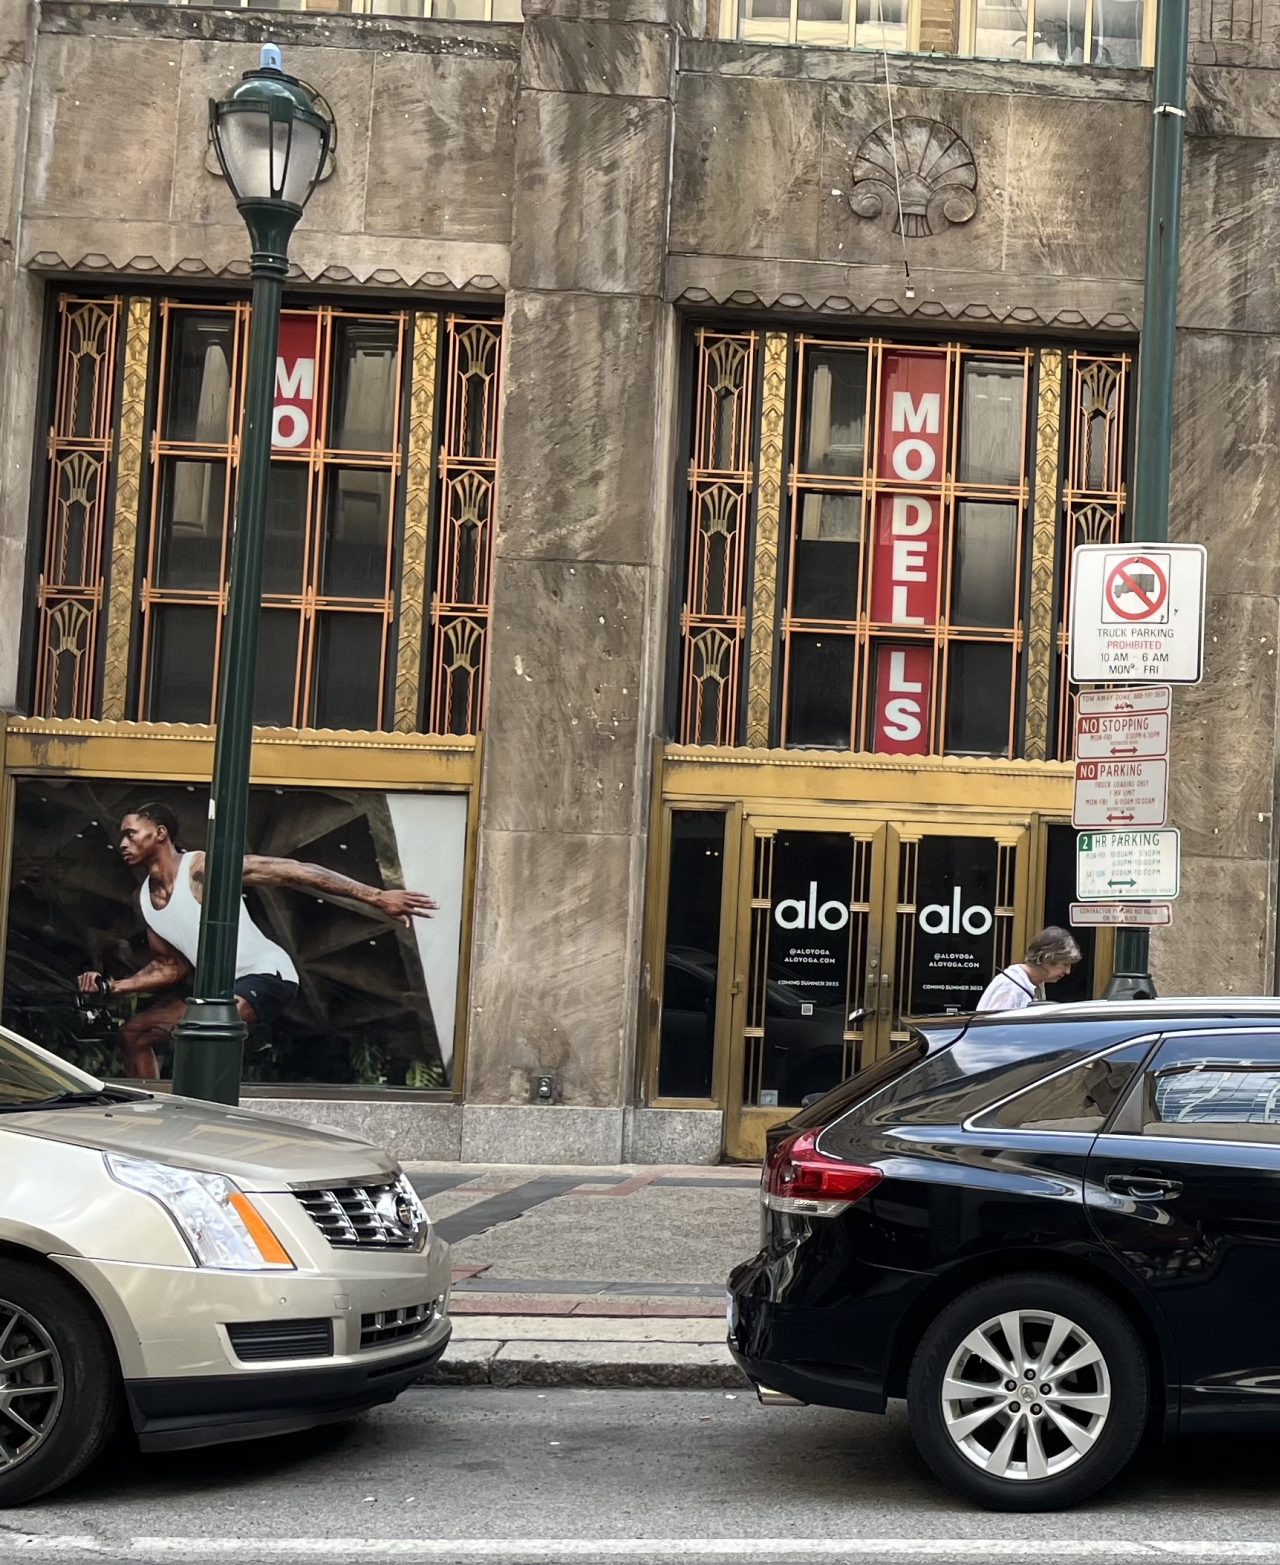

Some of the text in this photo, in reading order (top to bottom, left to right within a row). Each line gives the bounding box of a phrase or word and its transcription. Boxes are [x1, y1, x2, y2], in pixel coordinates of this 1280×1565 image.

[1098, 628, 1175, 638] TRUCK PARKING
[1107, 640, 1162, 650] PROHIBITED
[1101, 653, 1110, 662] 10
[1113, 653, 1128, 662] AM
[1142, 653, 1148, 662] 6
[1152, 653, 1169, 662] AM
[1109, 665, 1130, 674] MON
[1143, 665, 1159, 674] FRI
[1082, 717, 1149, 733] NO STOPPING
[1080, 763, 1142, 778] NO PARKING
[1082, 833, 1160, 850] 2 HR PARKING
[774, 881, 849, 931] alo
[919, 886, 993, 936] alo
[789, 948, 830, 956] @ALOYOGA
[934, 952, 974, 960] @ALOYOGA
[784, 956, 836, 964] ALOYOGA.COM
